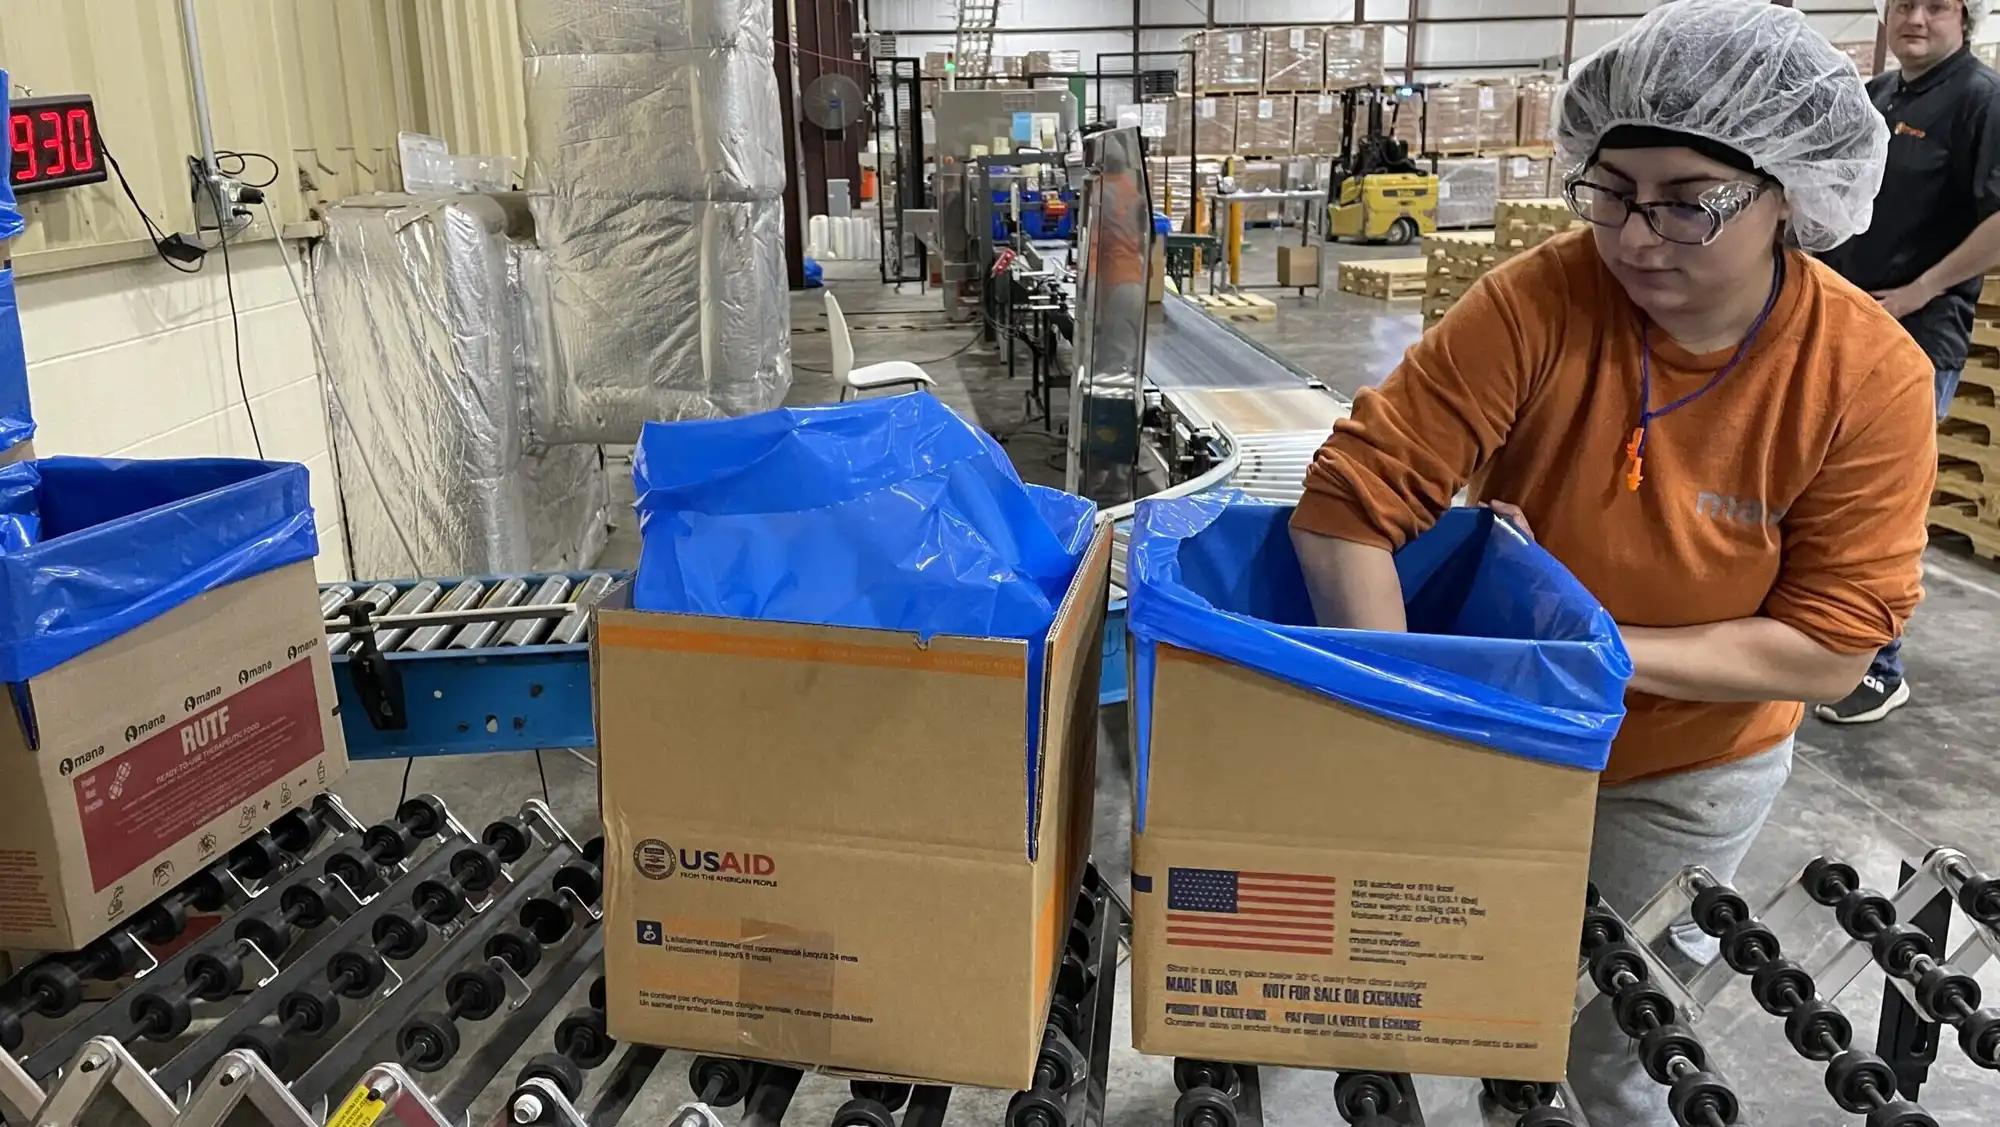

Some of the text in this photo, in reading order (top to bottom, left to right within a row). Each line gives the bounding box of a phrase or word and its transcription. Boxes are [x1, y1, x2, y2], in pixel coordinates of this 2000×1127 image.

[1696, 491, 1787, 525] ma
[74, 637, 318, 768] mana mana mana mana mana
[180, 705, 230, 756] RUTF
[680, 848, 775, 876] USAID
[680, 872, 699, 880] FROM
[716, 875, 751, 885] AMERICAN
[753, 879, 777, 887] PEOPLE
[710, 939, 741, 949] maternel
[830, 952, 839, 961] 24
[841, 954, 858, 963] mois
[1166, 964, 1189, 973] Store
[1166, 976, 1238, 996] MADE IN USA
[1263, 983, 1422, 1008] NOT FOR SALE OR EXCHANGE
[639, 990, 649, 998] Ne
[678, 994, 690, 1003] pas
[794, 1008, 821, 1018] d'autres
[639, 998, 649, 1007] Un
[711, 1007, 721, 1015] Ne
[722, 1009, 735, 1018] pas
[1285, 1011, 1302, 1023] PAS
[1327, 1014, 1338, 1026] LA
[1339, 1015, 1367, 1028] VENTE
